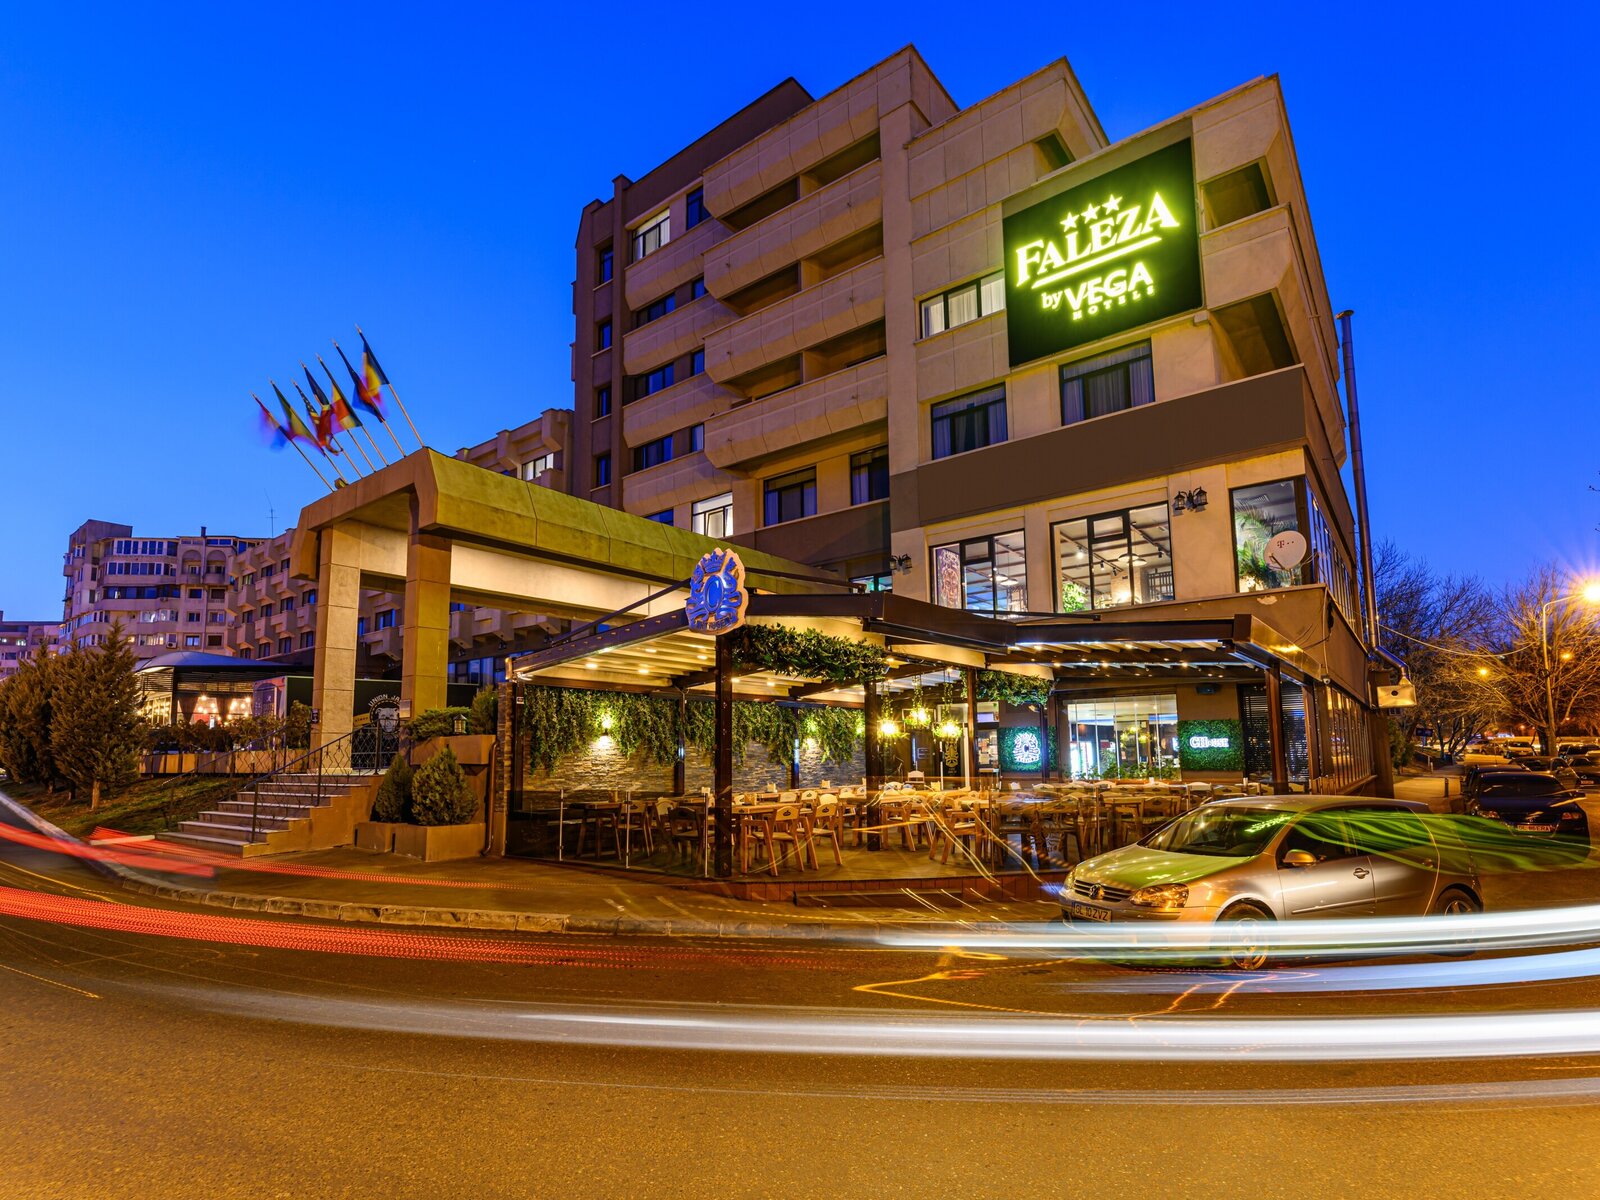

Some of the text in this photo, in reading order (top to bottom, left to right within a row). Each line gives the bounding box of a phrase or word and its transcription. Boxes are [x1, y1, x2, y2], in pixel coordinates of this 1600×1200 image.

[1015, 191, 1180, 287] FALEZA
[1041, 261, 1153, 311] by VEGA
[1072, 283, 1156, 321] HOTELS
